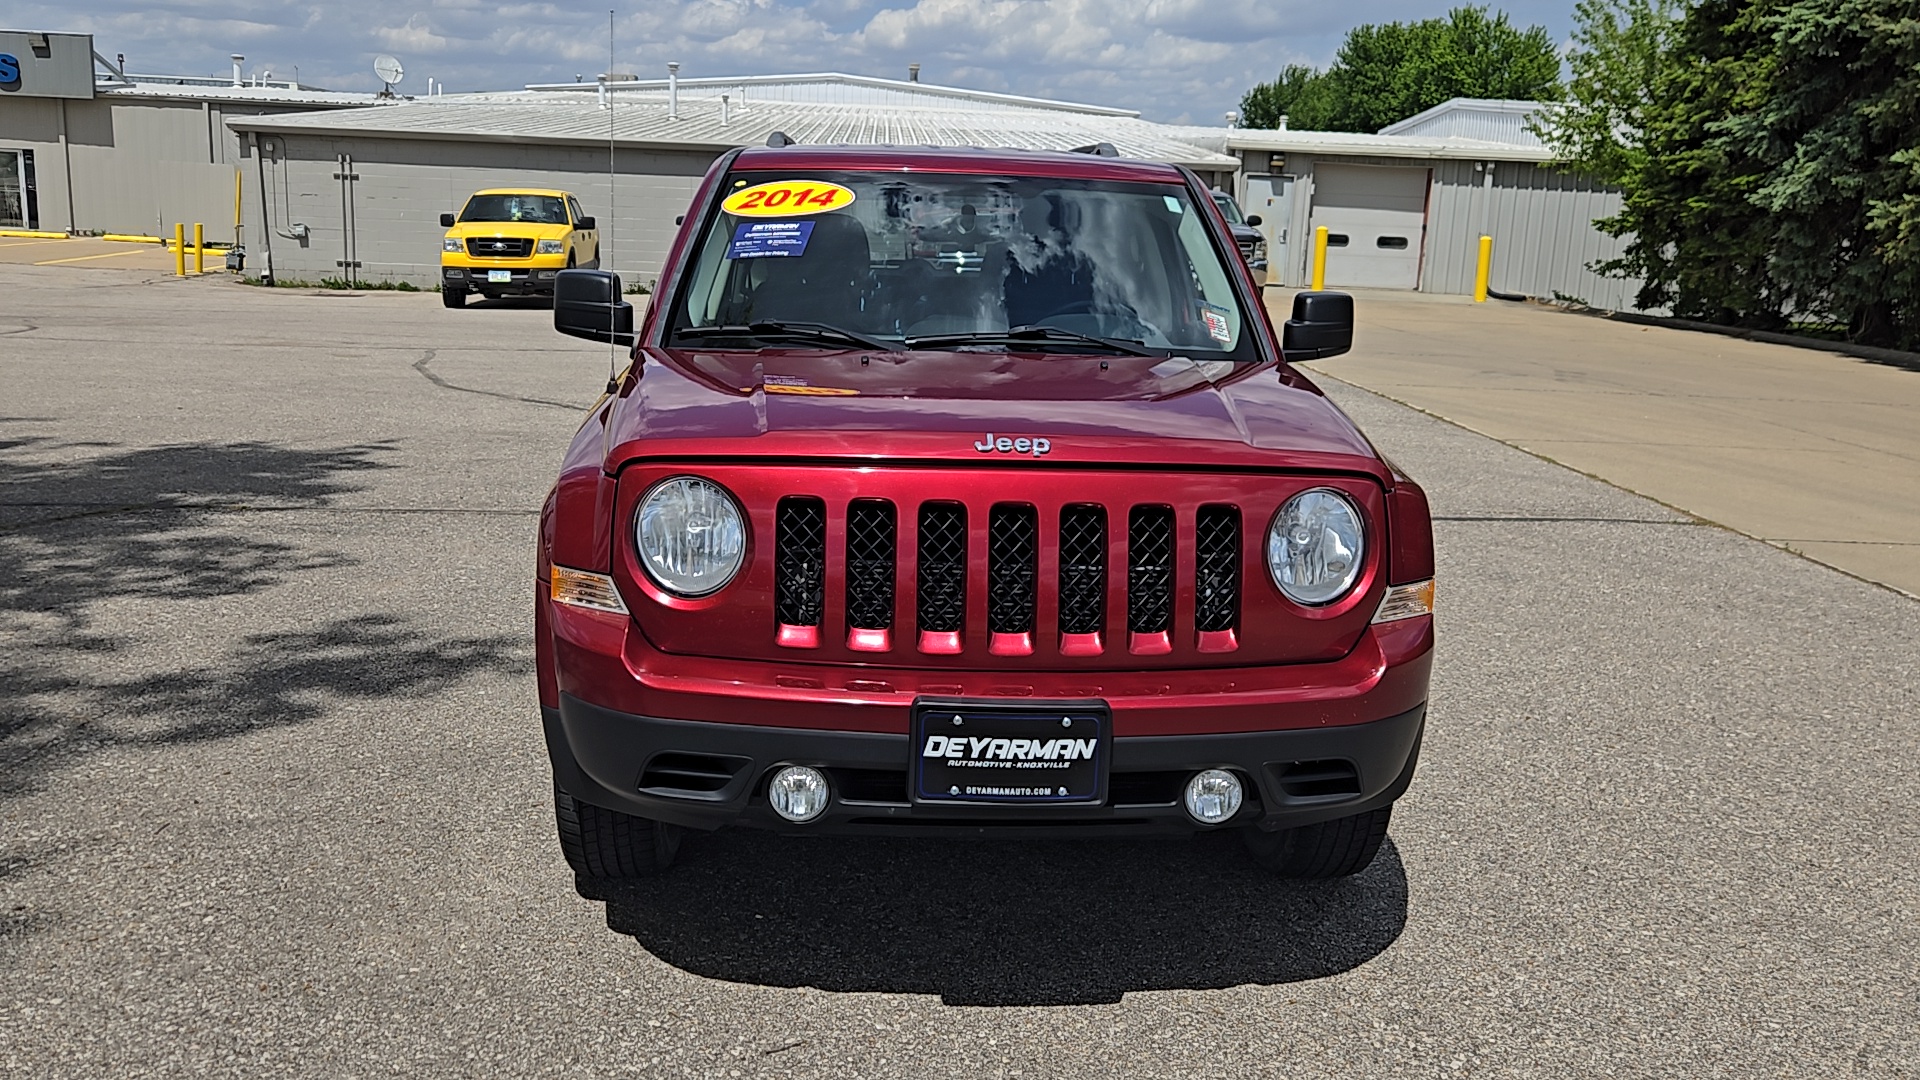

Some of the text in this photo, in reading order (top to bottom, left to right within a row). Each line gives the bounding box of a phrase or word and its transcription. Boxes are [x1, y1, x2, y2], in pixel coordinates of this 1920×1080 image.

[735, 188, 840, 210] 2014
[974, 432, 1051, 457] Jeep
[923, 735, 1097, 760] DEYARMAN
[966, 786, 1052, 796] DEYARMANAUTO.COM
